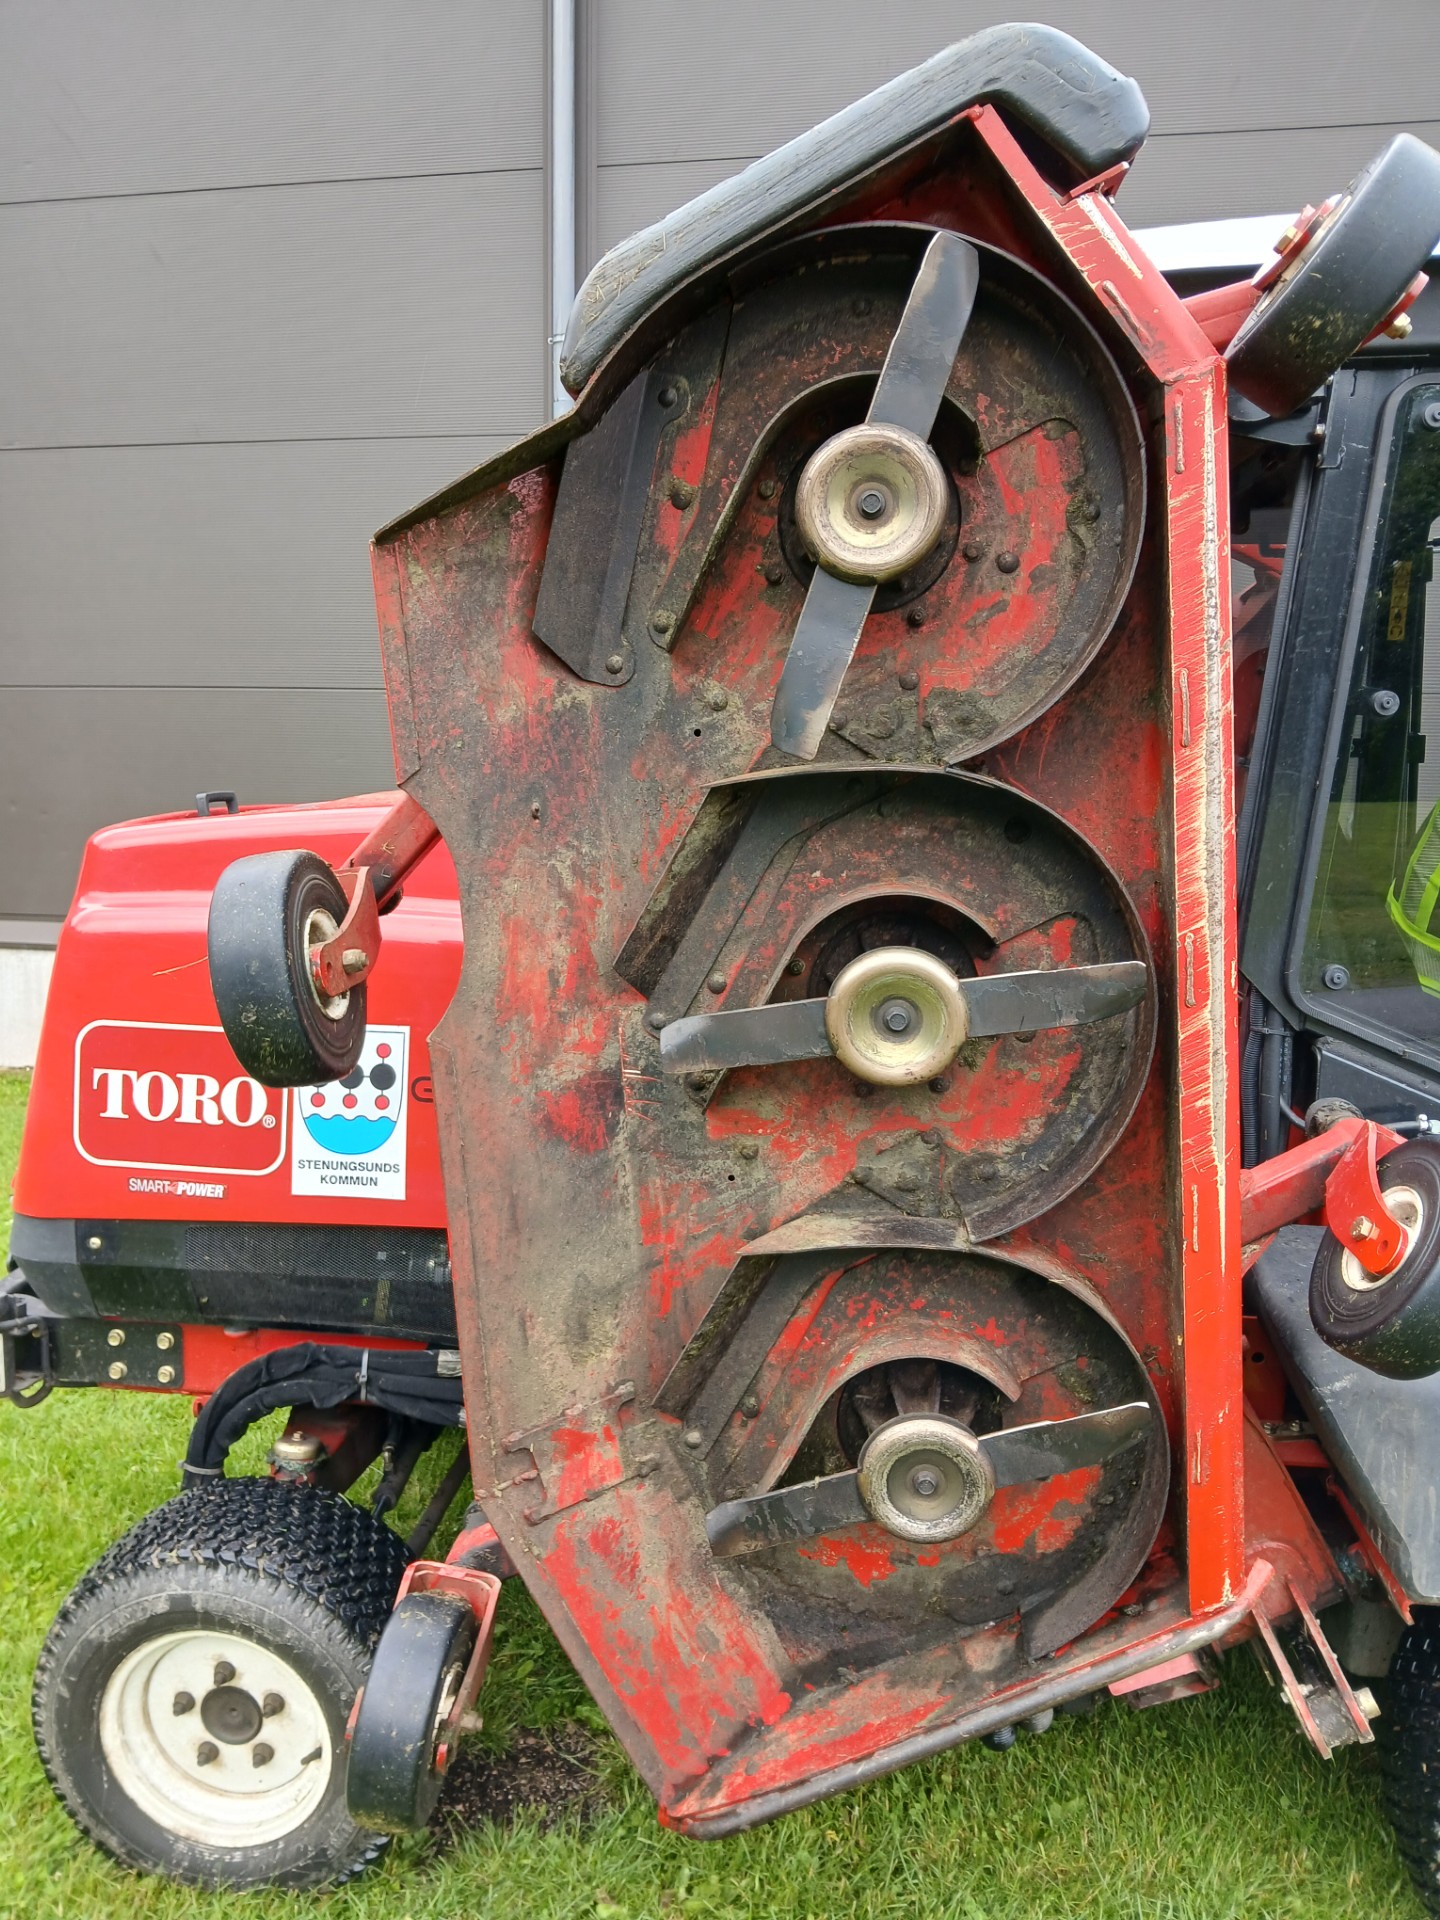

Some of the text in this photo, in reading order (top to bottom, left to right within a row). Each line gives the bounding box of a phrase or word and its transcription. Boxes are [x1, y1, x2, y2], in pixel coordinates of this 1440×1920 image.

[298, 1159, 401, 1174] STENUNGSUNDS
[129, 1177, 225, 1198] SMART POWER
[320, 1174, 379, 1187] KOMMUN
